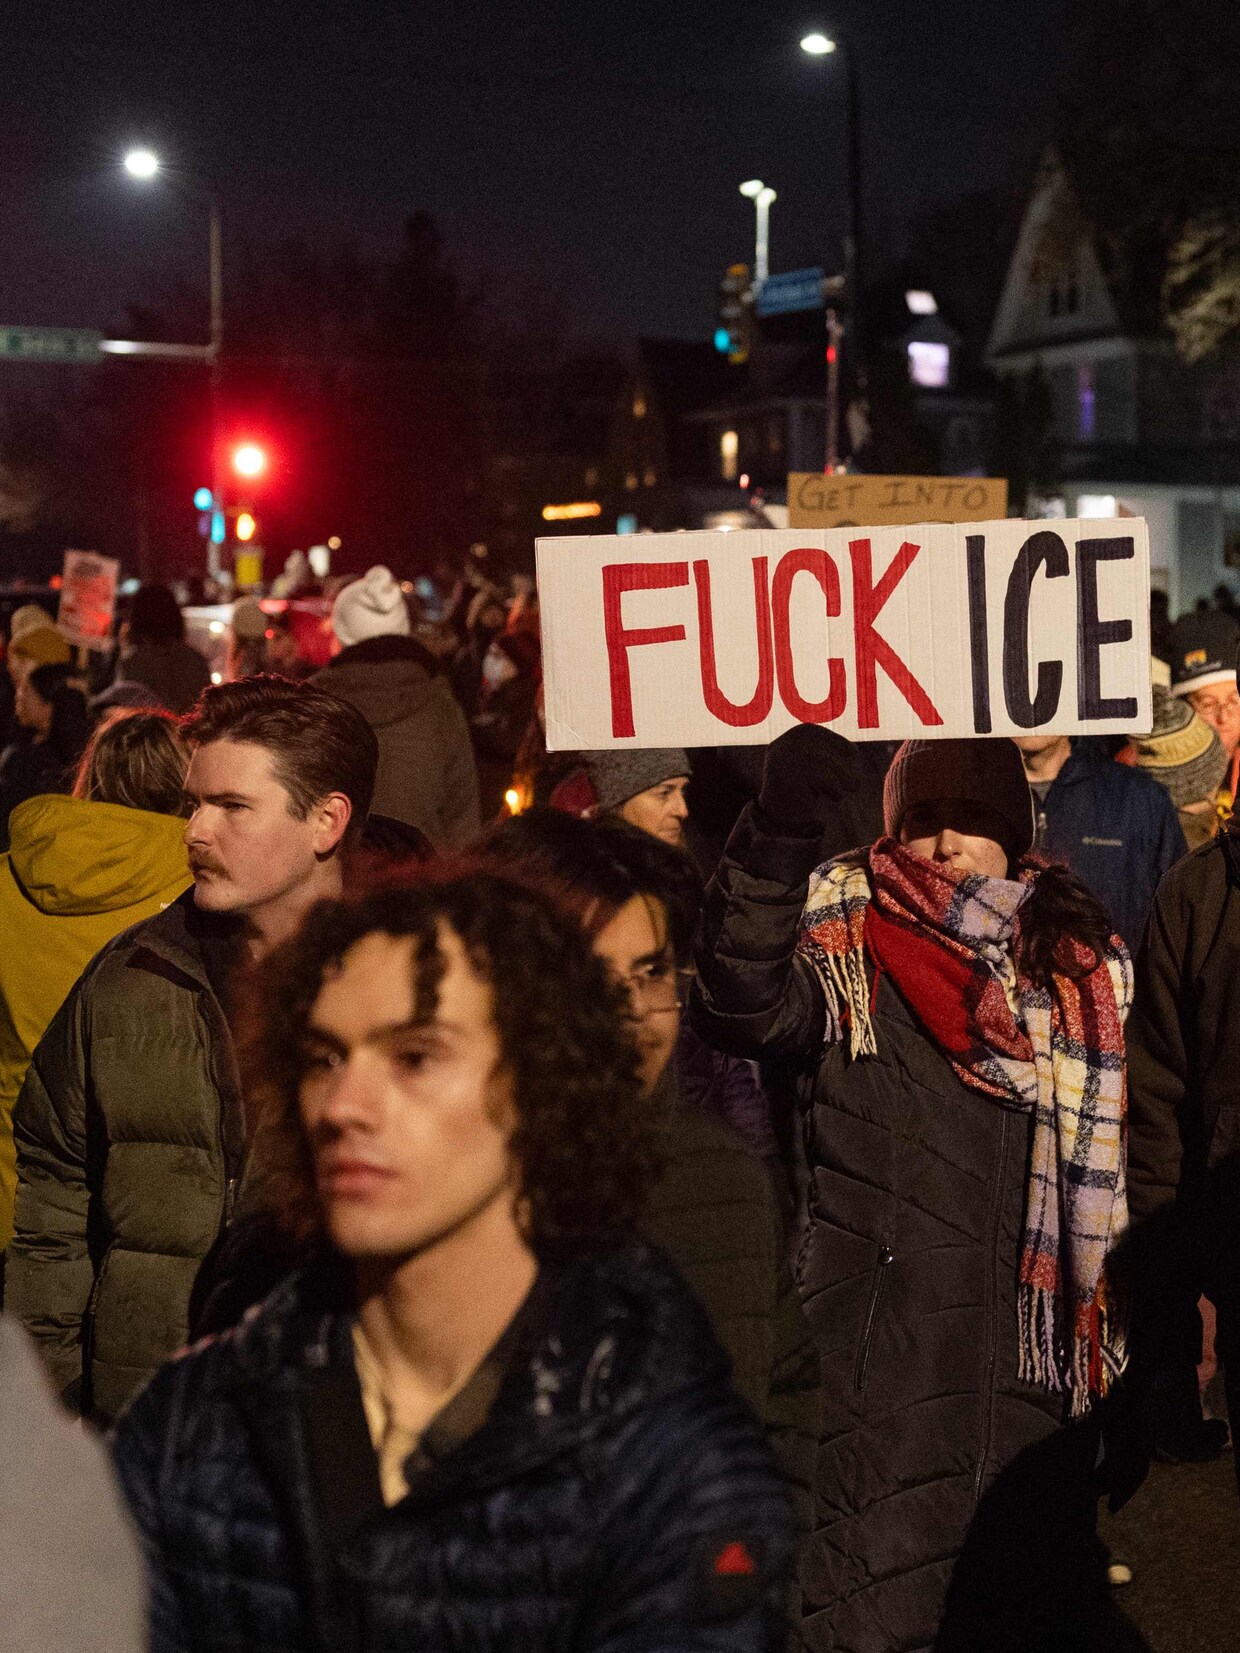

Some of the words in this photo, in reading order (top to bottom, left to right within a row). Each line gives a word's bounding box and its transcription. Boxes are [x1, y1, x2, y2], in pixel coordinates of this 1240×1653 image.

[797, 474, 864, 511] GET
[878, 480, 988, 511] INTO
[602, 538, 944, 738] FUCK
[965, 530, 1138, 734] ICE
